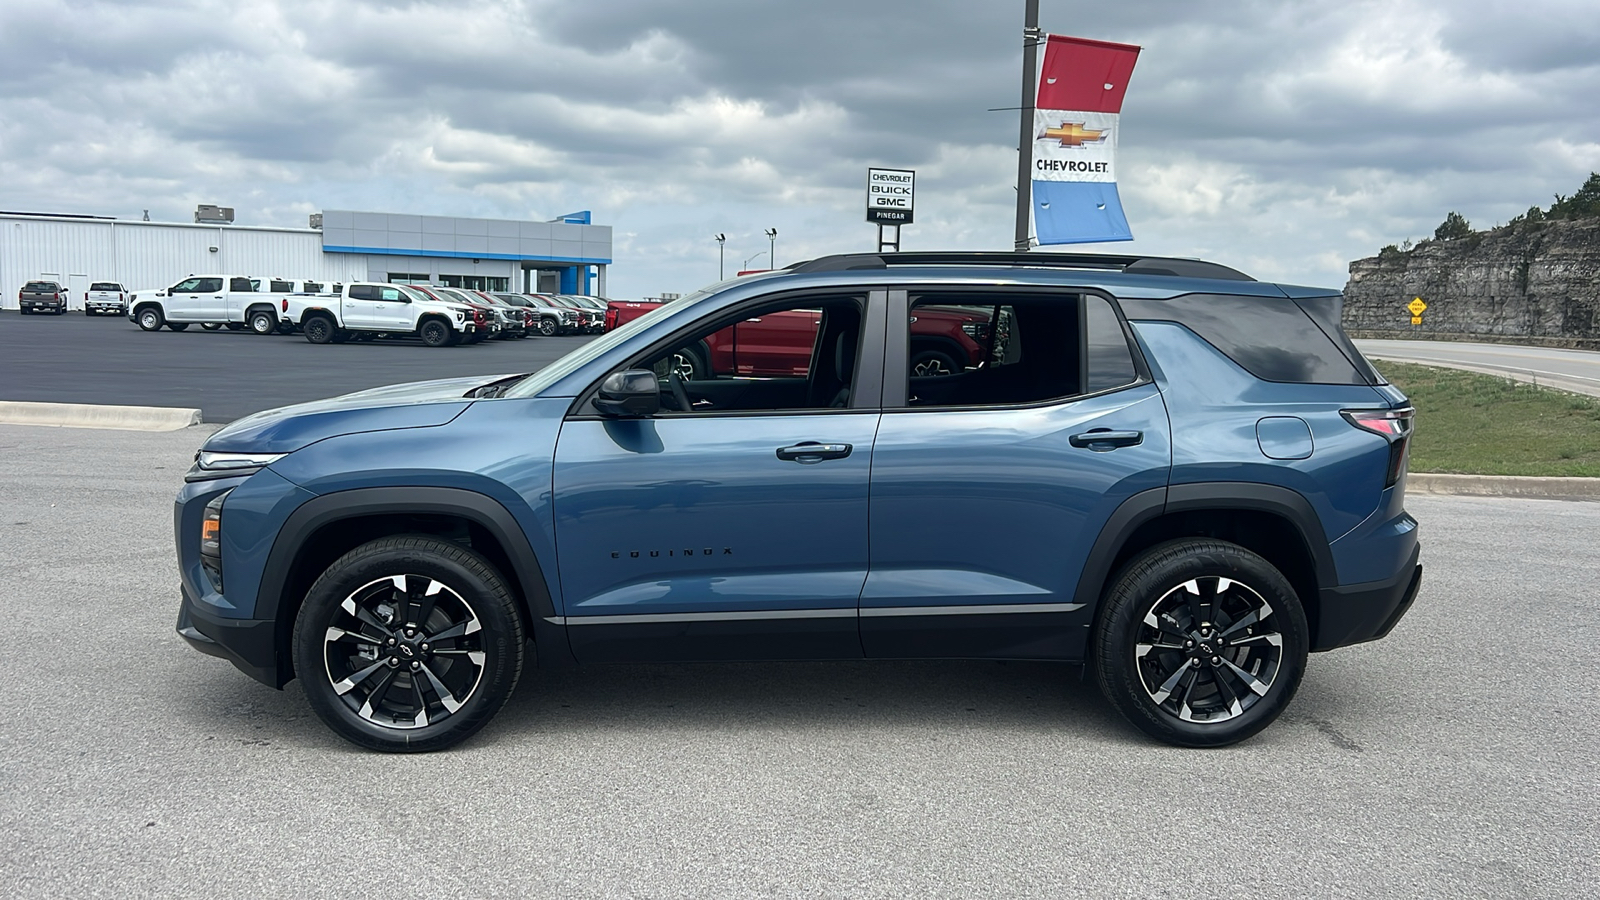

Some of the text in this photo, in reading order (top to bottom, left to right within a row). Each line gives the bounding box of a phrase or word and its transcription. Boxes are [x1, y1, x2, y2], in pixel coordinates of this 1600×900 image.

[1036, 159, 1108, 173] CHEVROLET
[872, 174, 911, 183] CHEVROLET
[871, 185, 911, 195] BUICK
[876, 197, 906, 206] GMC
[876, 211, 905, 220] PINEGAR
[610, 546, 733, 559] EQUINOX
